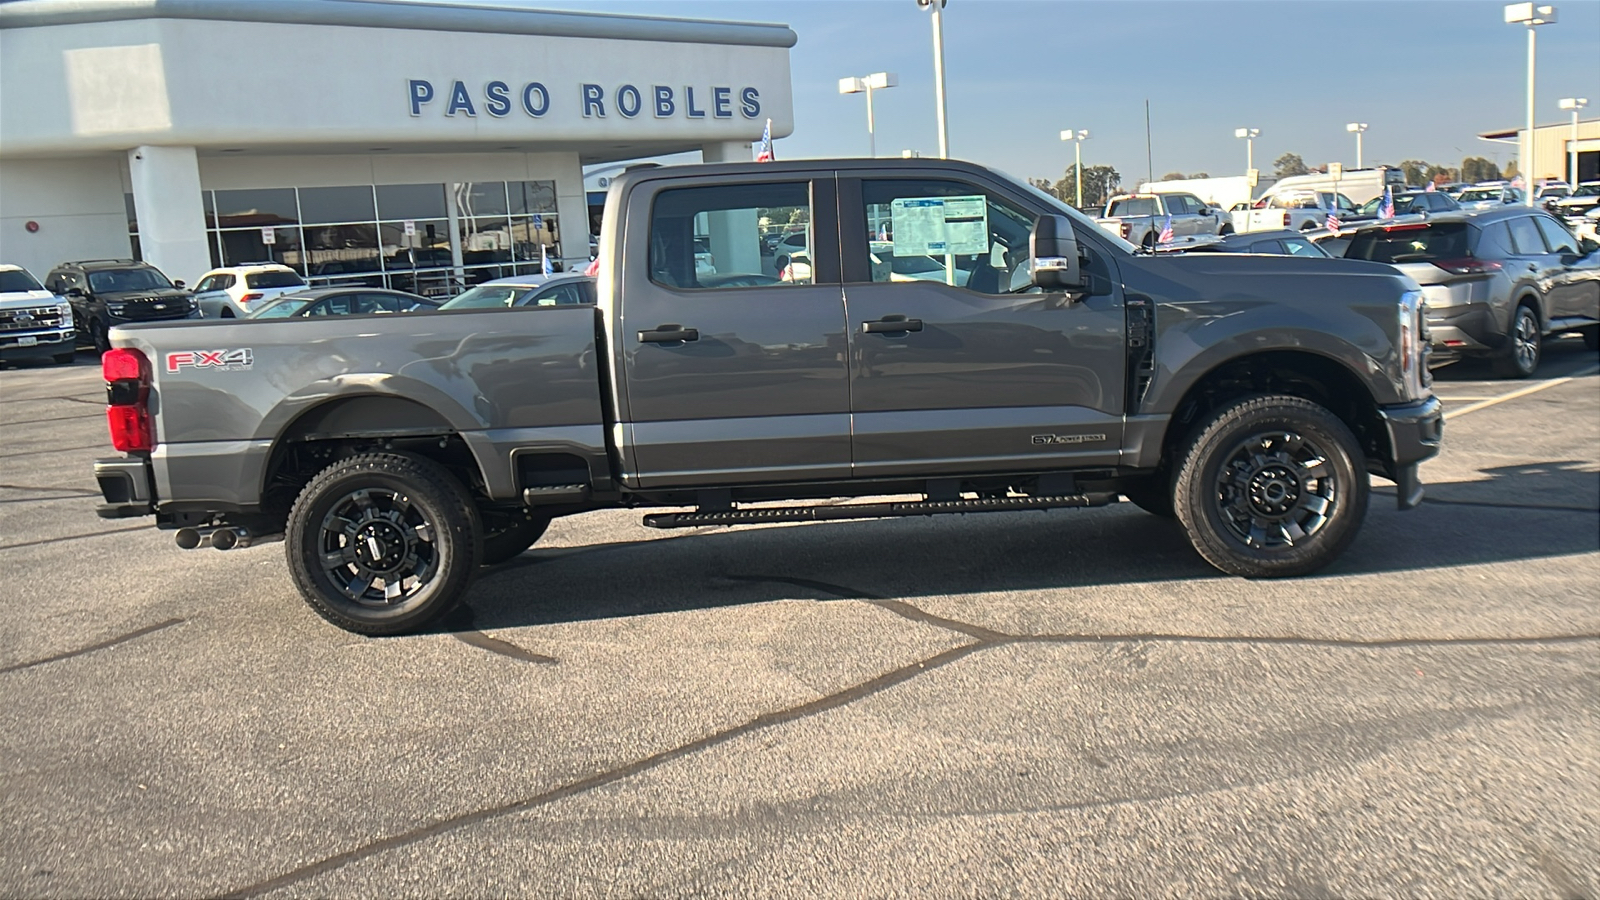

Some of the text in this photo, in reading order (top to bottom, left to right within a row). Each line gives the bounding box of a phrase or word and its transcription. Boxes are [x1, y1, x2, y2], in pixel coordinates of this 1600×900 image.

[408, 79, 762, 119] PASO ROBLES
[166, 348, 253, 373] FX4
